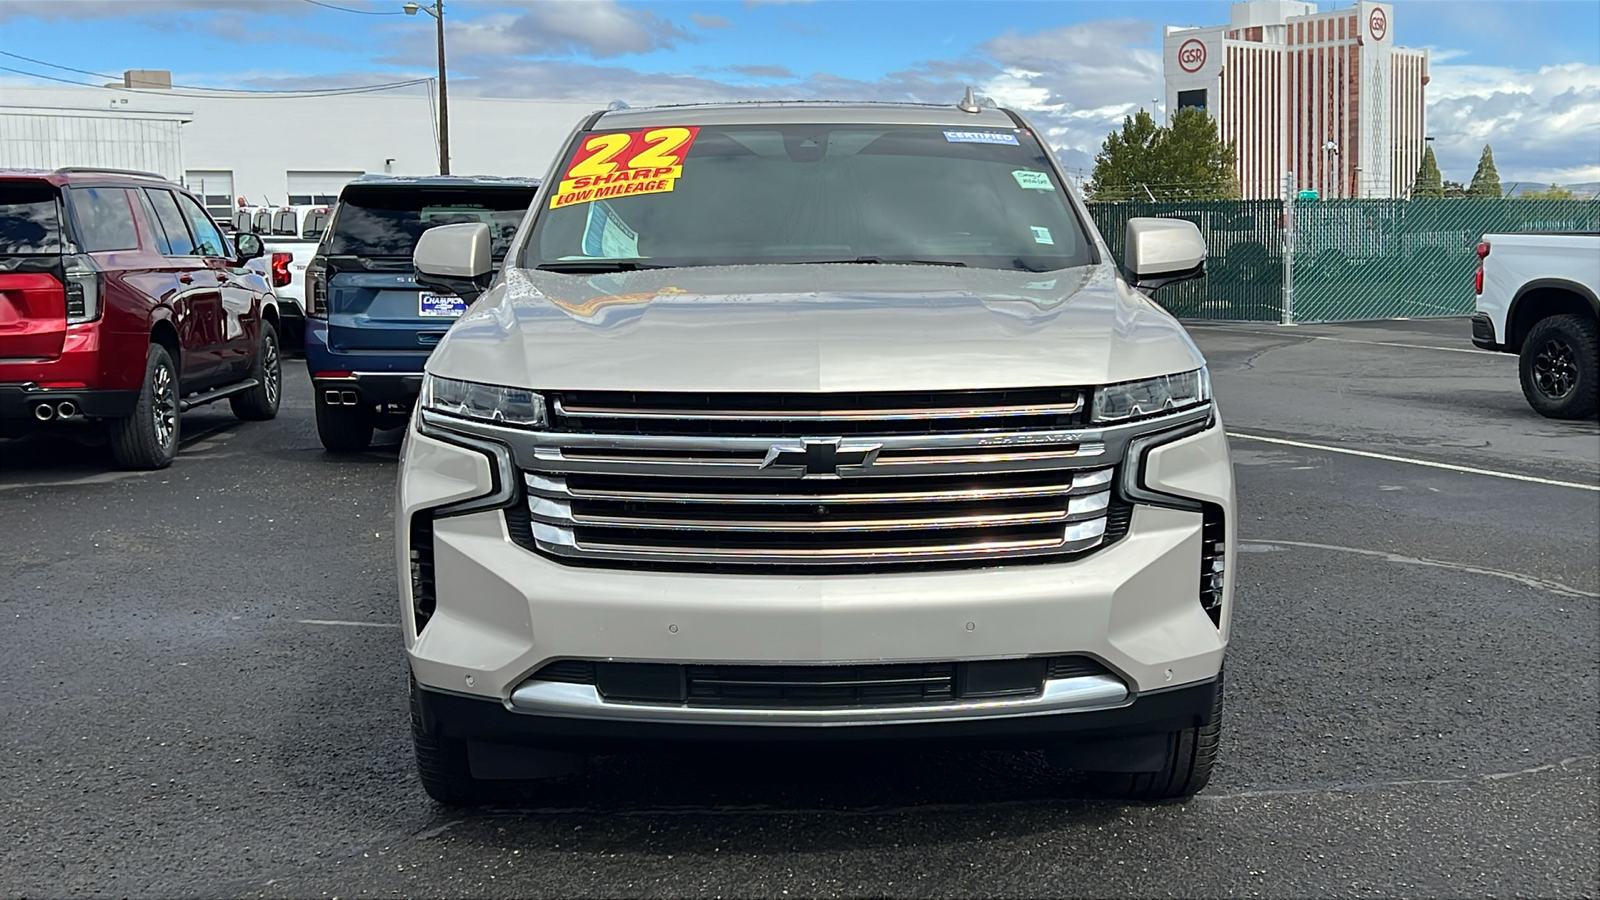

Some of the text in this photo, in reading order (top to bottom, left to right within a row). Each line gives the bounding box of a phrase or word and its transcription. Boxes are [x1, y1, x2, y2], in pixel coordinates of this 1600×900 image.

[1371, 17, 1384, 31] GSR
[1181, 48, 1203, 63] GSR
[947, 131, 1014, 141] CERTIFIED
[568, 127, 692, 178] 22
[572, 166, 674, 189] SHARP
[555, 179, 669, 206] LOW MILEAGE
[422, 295, 465, 305] CHAMPION
[1016, 433, 1083, 443] COUNTRY
